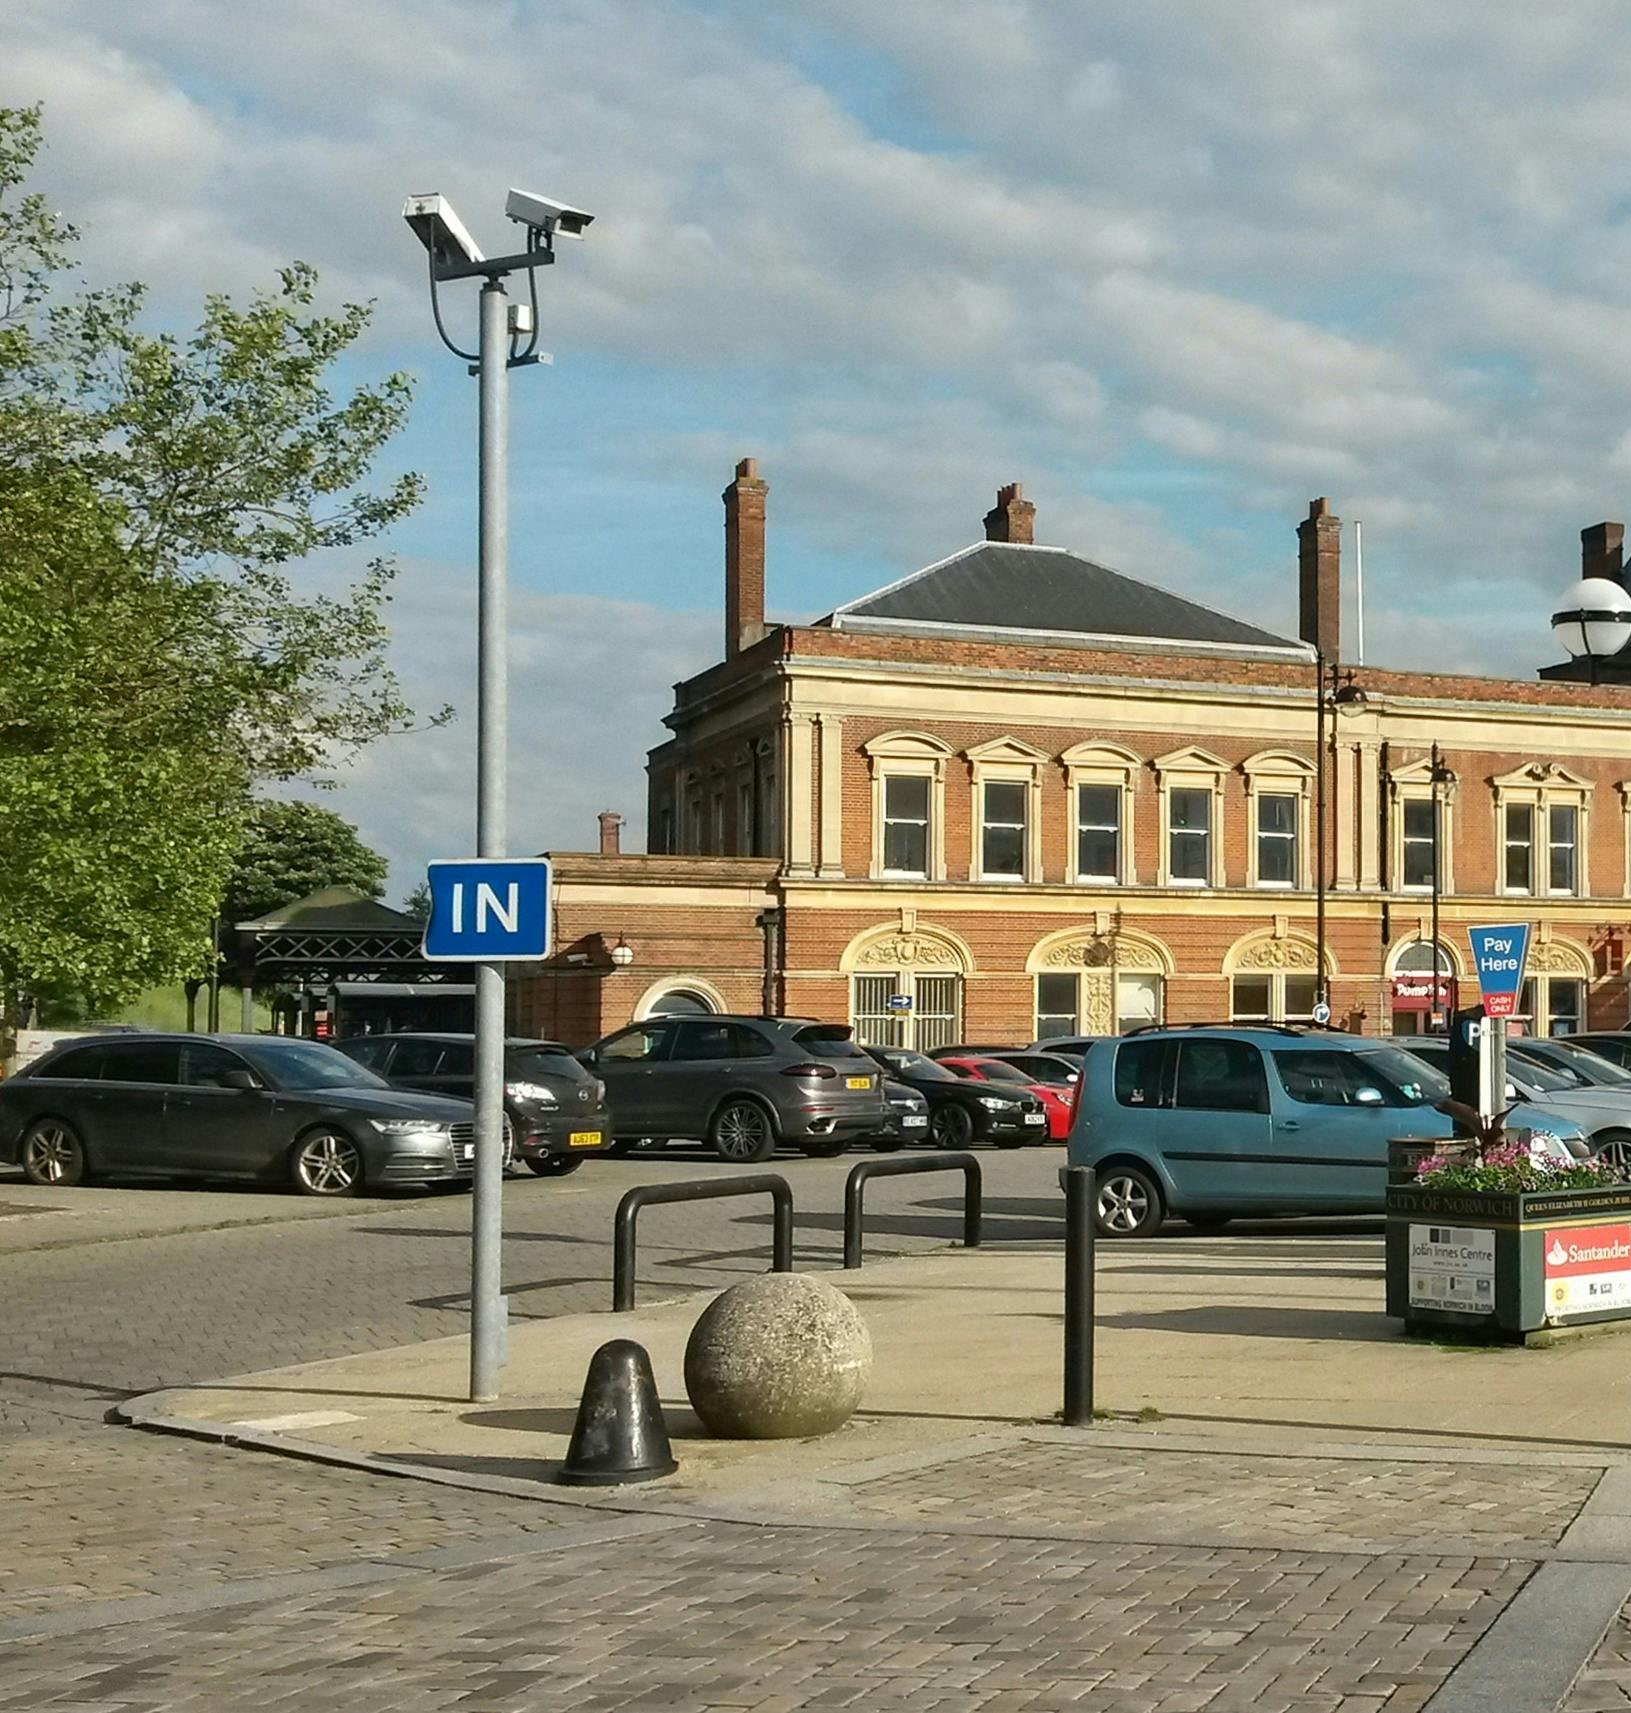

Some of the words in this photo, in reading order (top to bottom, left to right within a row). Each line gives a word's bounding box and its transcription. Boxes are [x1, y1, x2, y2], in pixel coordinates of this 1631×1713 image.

[452, 882, 518, 933] IN
[1484, 938, 1512, 954] Pay
[1481, 958, 1518, 971] Here
[1490, 1005, 1511, 1013] ONLY
[1388, 1193, 1417, 1209] CITY
[1422, 1194, 1440, 1211] OF
[1443, 1197, 1513, 1216] NORWICH
[1412, 1244, 1433, 1257] John
[1434, 1245, 1458, 1258] Innes
[1460, 1247, 1493, 1261] Centre
[1569, 1239, 1631, 1263] Santander
